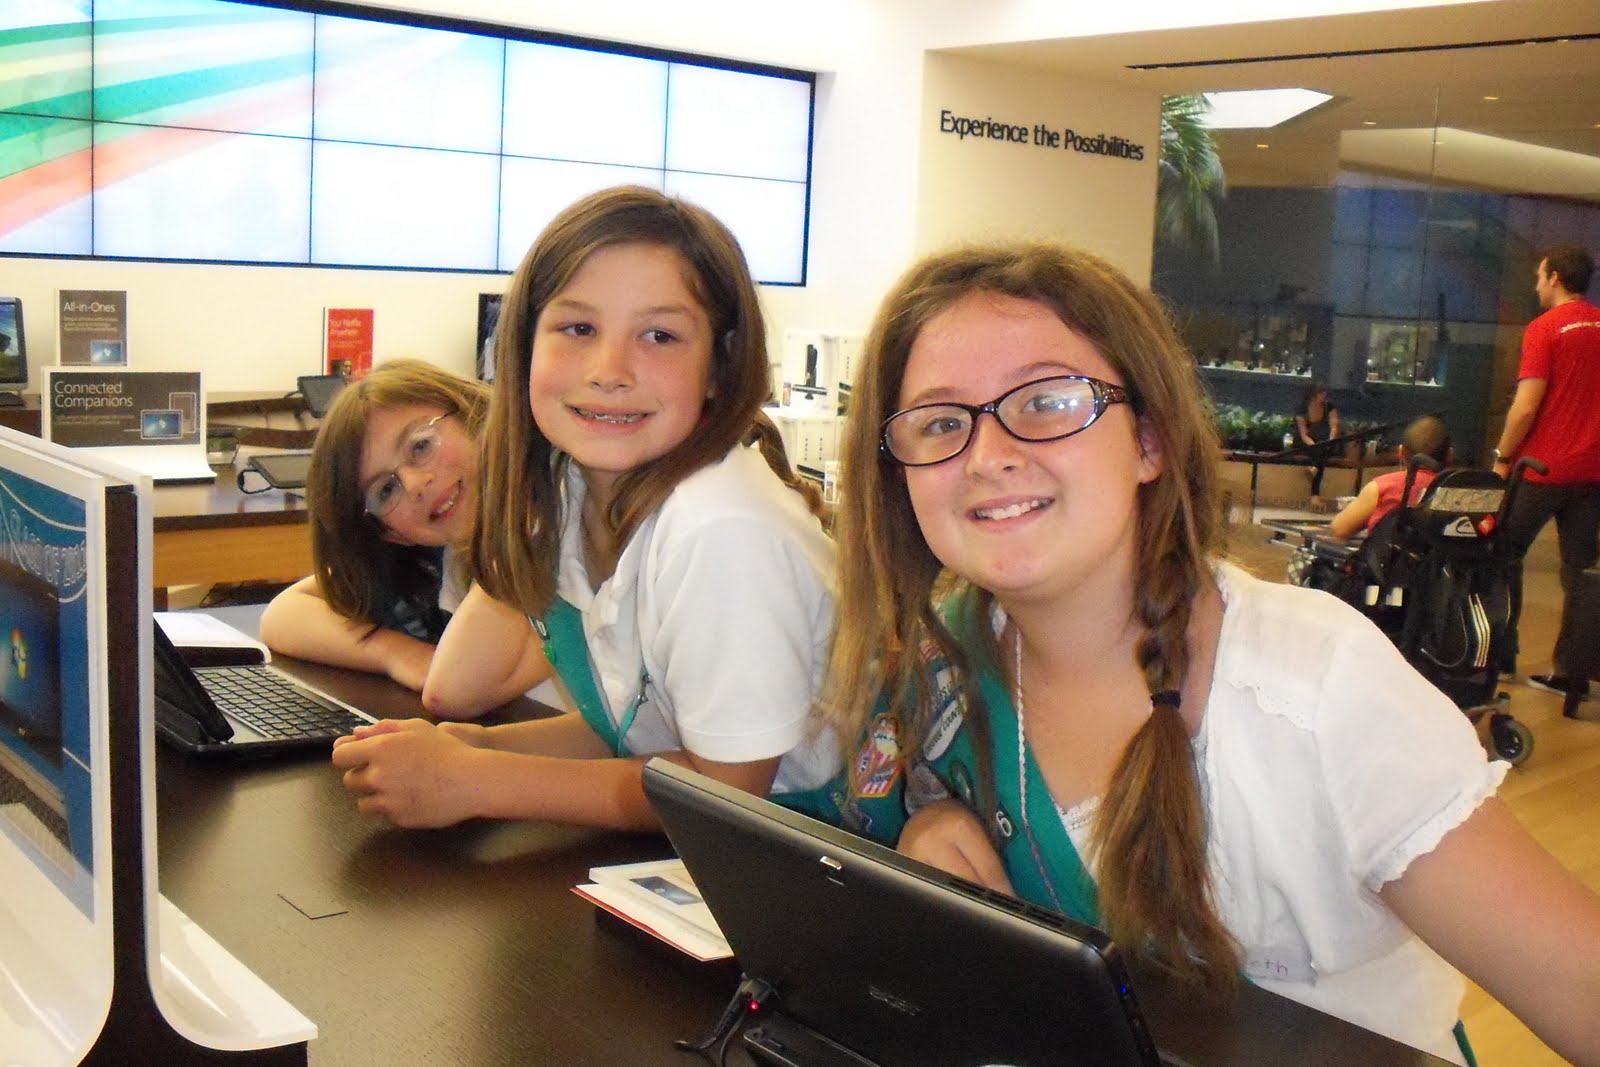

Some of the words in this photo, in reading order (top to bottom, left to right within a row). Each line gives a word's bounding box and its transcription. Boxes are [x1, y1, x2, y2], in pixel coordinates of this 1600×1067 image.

[940, 110, 1028, 143] Experience
[1034, 125, 1060, 148] the
[1064, 129, 1144, 161] Possibilities
[63, 301, 116, 312] All-in-Ones
[54, 381, 122, 394] Connected
[54, 394, 133, 411] Companions
[996, 811, 1012, 837] 6
